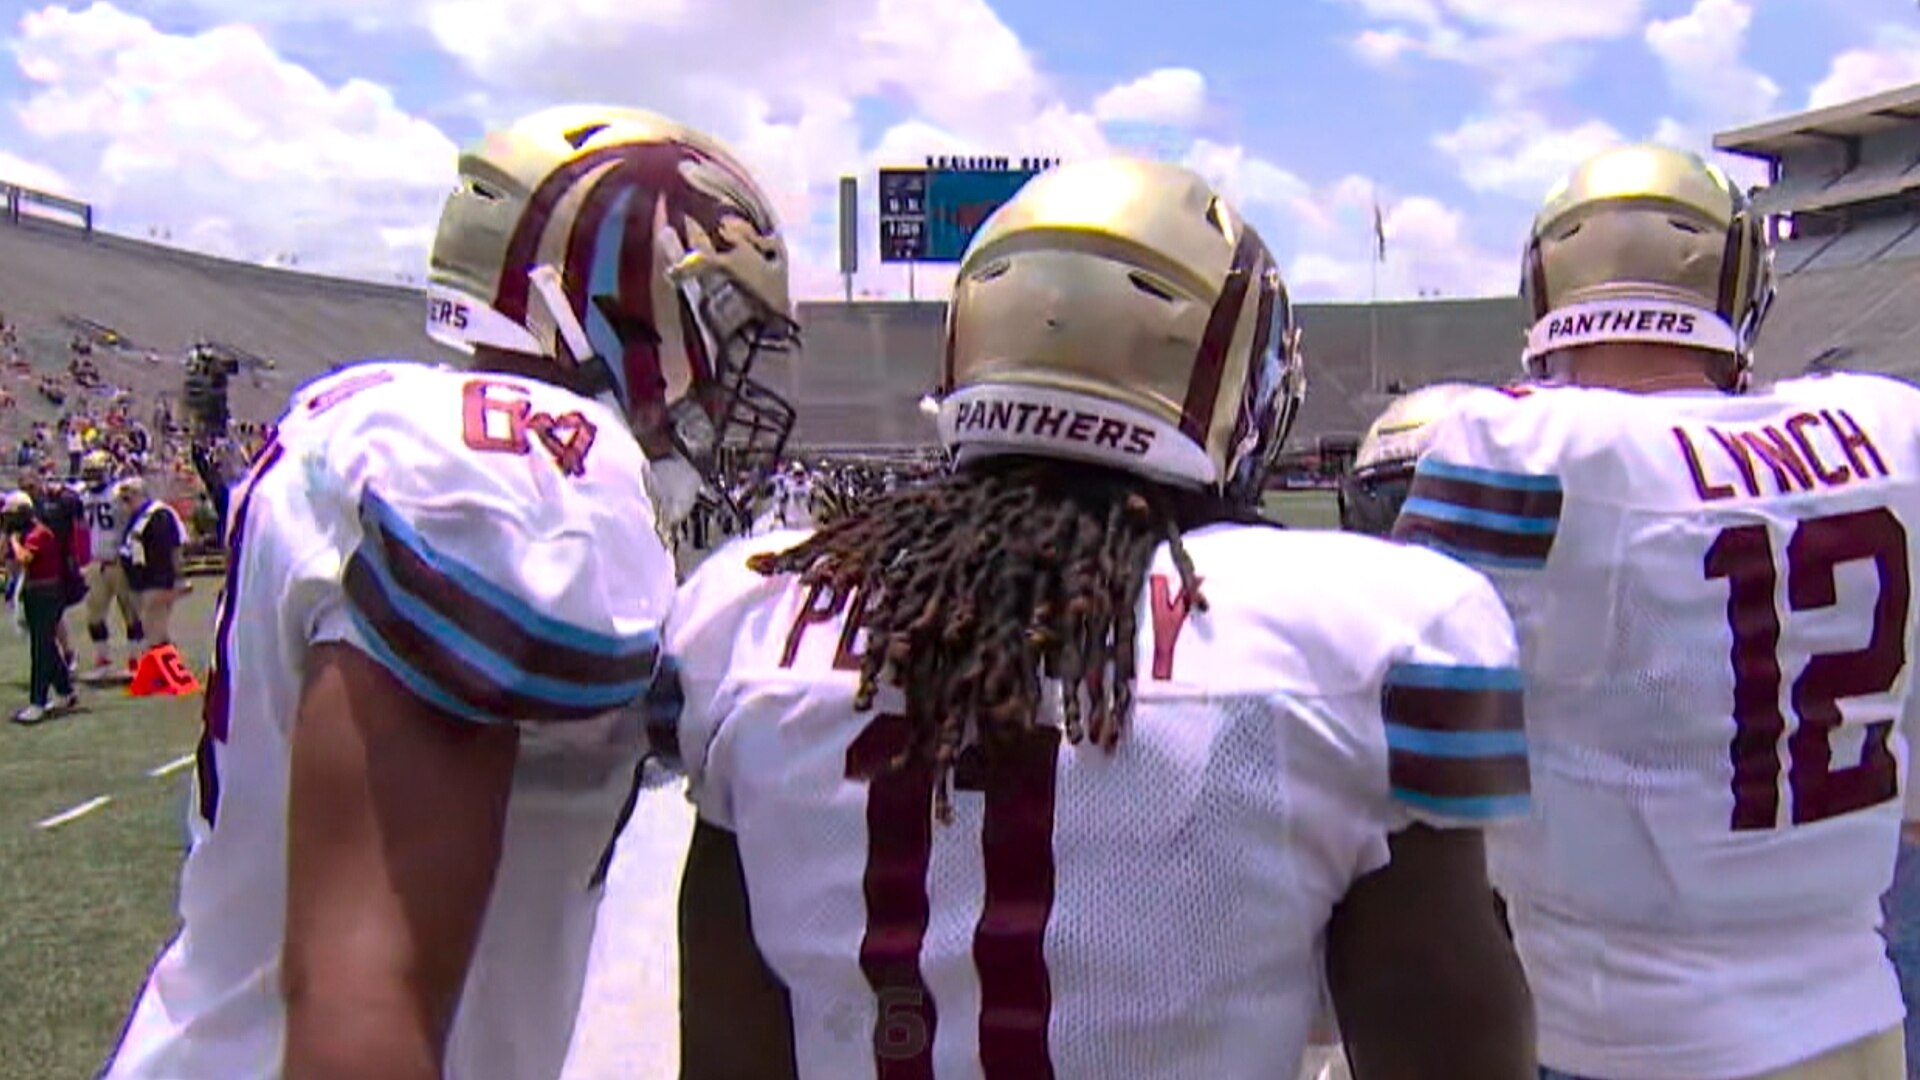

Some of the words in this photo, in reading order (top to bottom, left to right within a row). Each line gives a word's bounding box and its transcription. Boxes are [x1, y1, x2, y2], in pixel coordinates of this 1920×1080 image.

[1548, 309, 1697, 341] PANTHERS
[955, 401, 1156, 455] PANTHERS
[1672, 408, 1889, 502] LYNCH
[1703, 506, 1911, 832] 12
